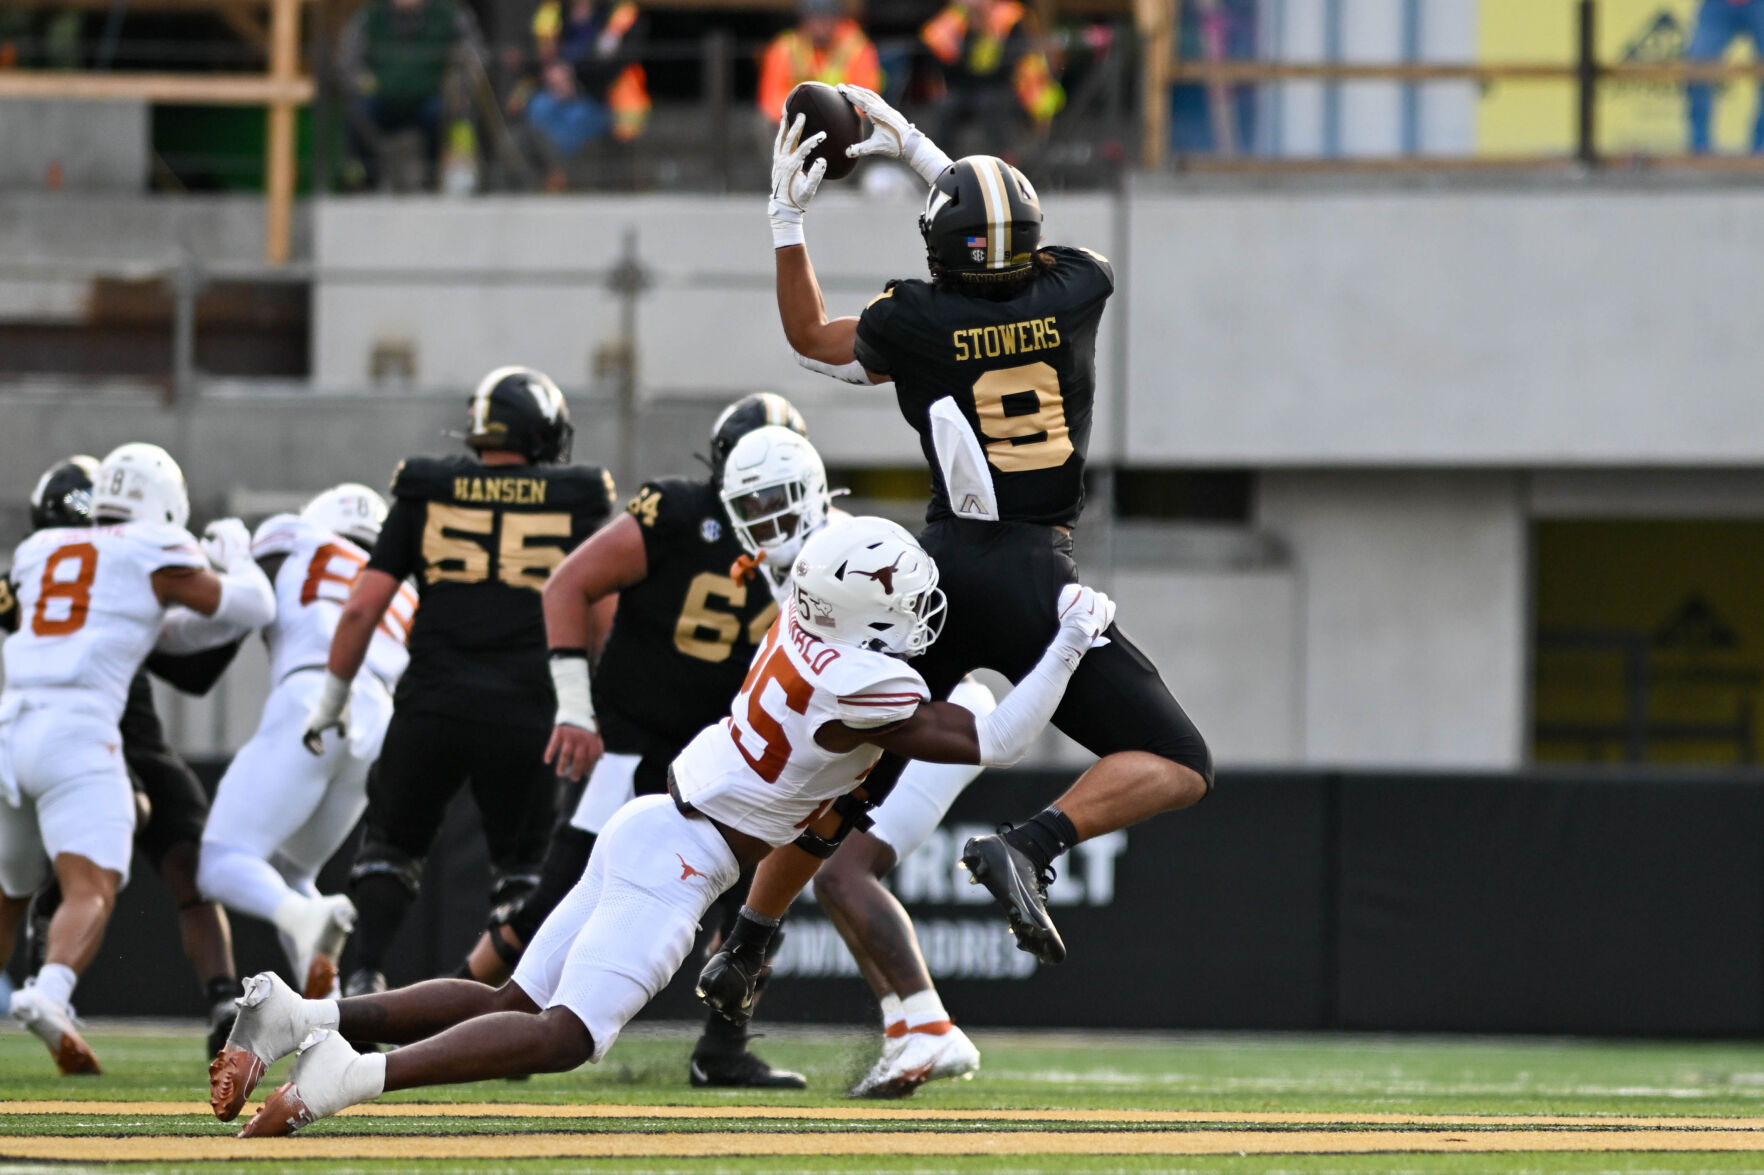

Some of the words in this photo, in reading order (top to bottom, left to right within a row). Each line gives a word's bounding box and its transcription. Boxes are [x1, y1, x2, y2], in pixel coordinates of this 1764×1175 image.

[971, 249, 986, 263] SEC
[953, 316, 1062, 361] STOWERS
[972, 360, 1074, 473] 9
[454, 476, 547, 504] HANSEN
[422, 501, 572, 592] 55
[31, 542, 99, 637] 8
[793, 580, 811, 621] 5
